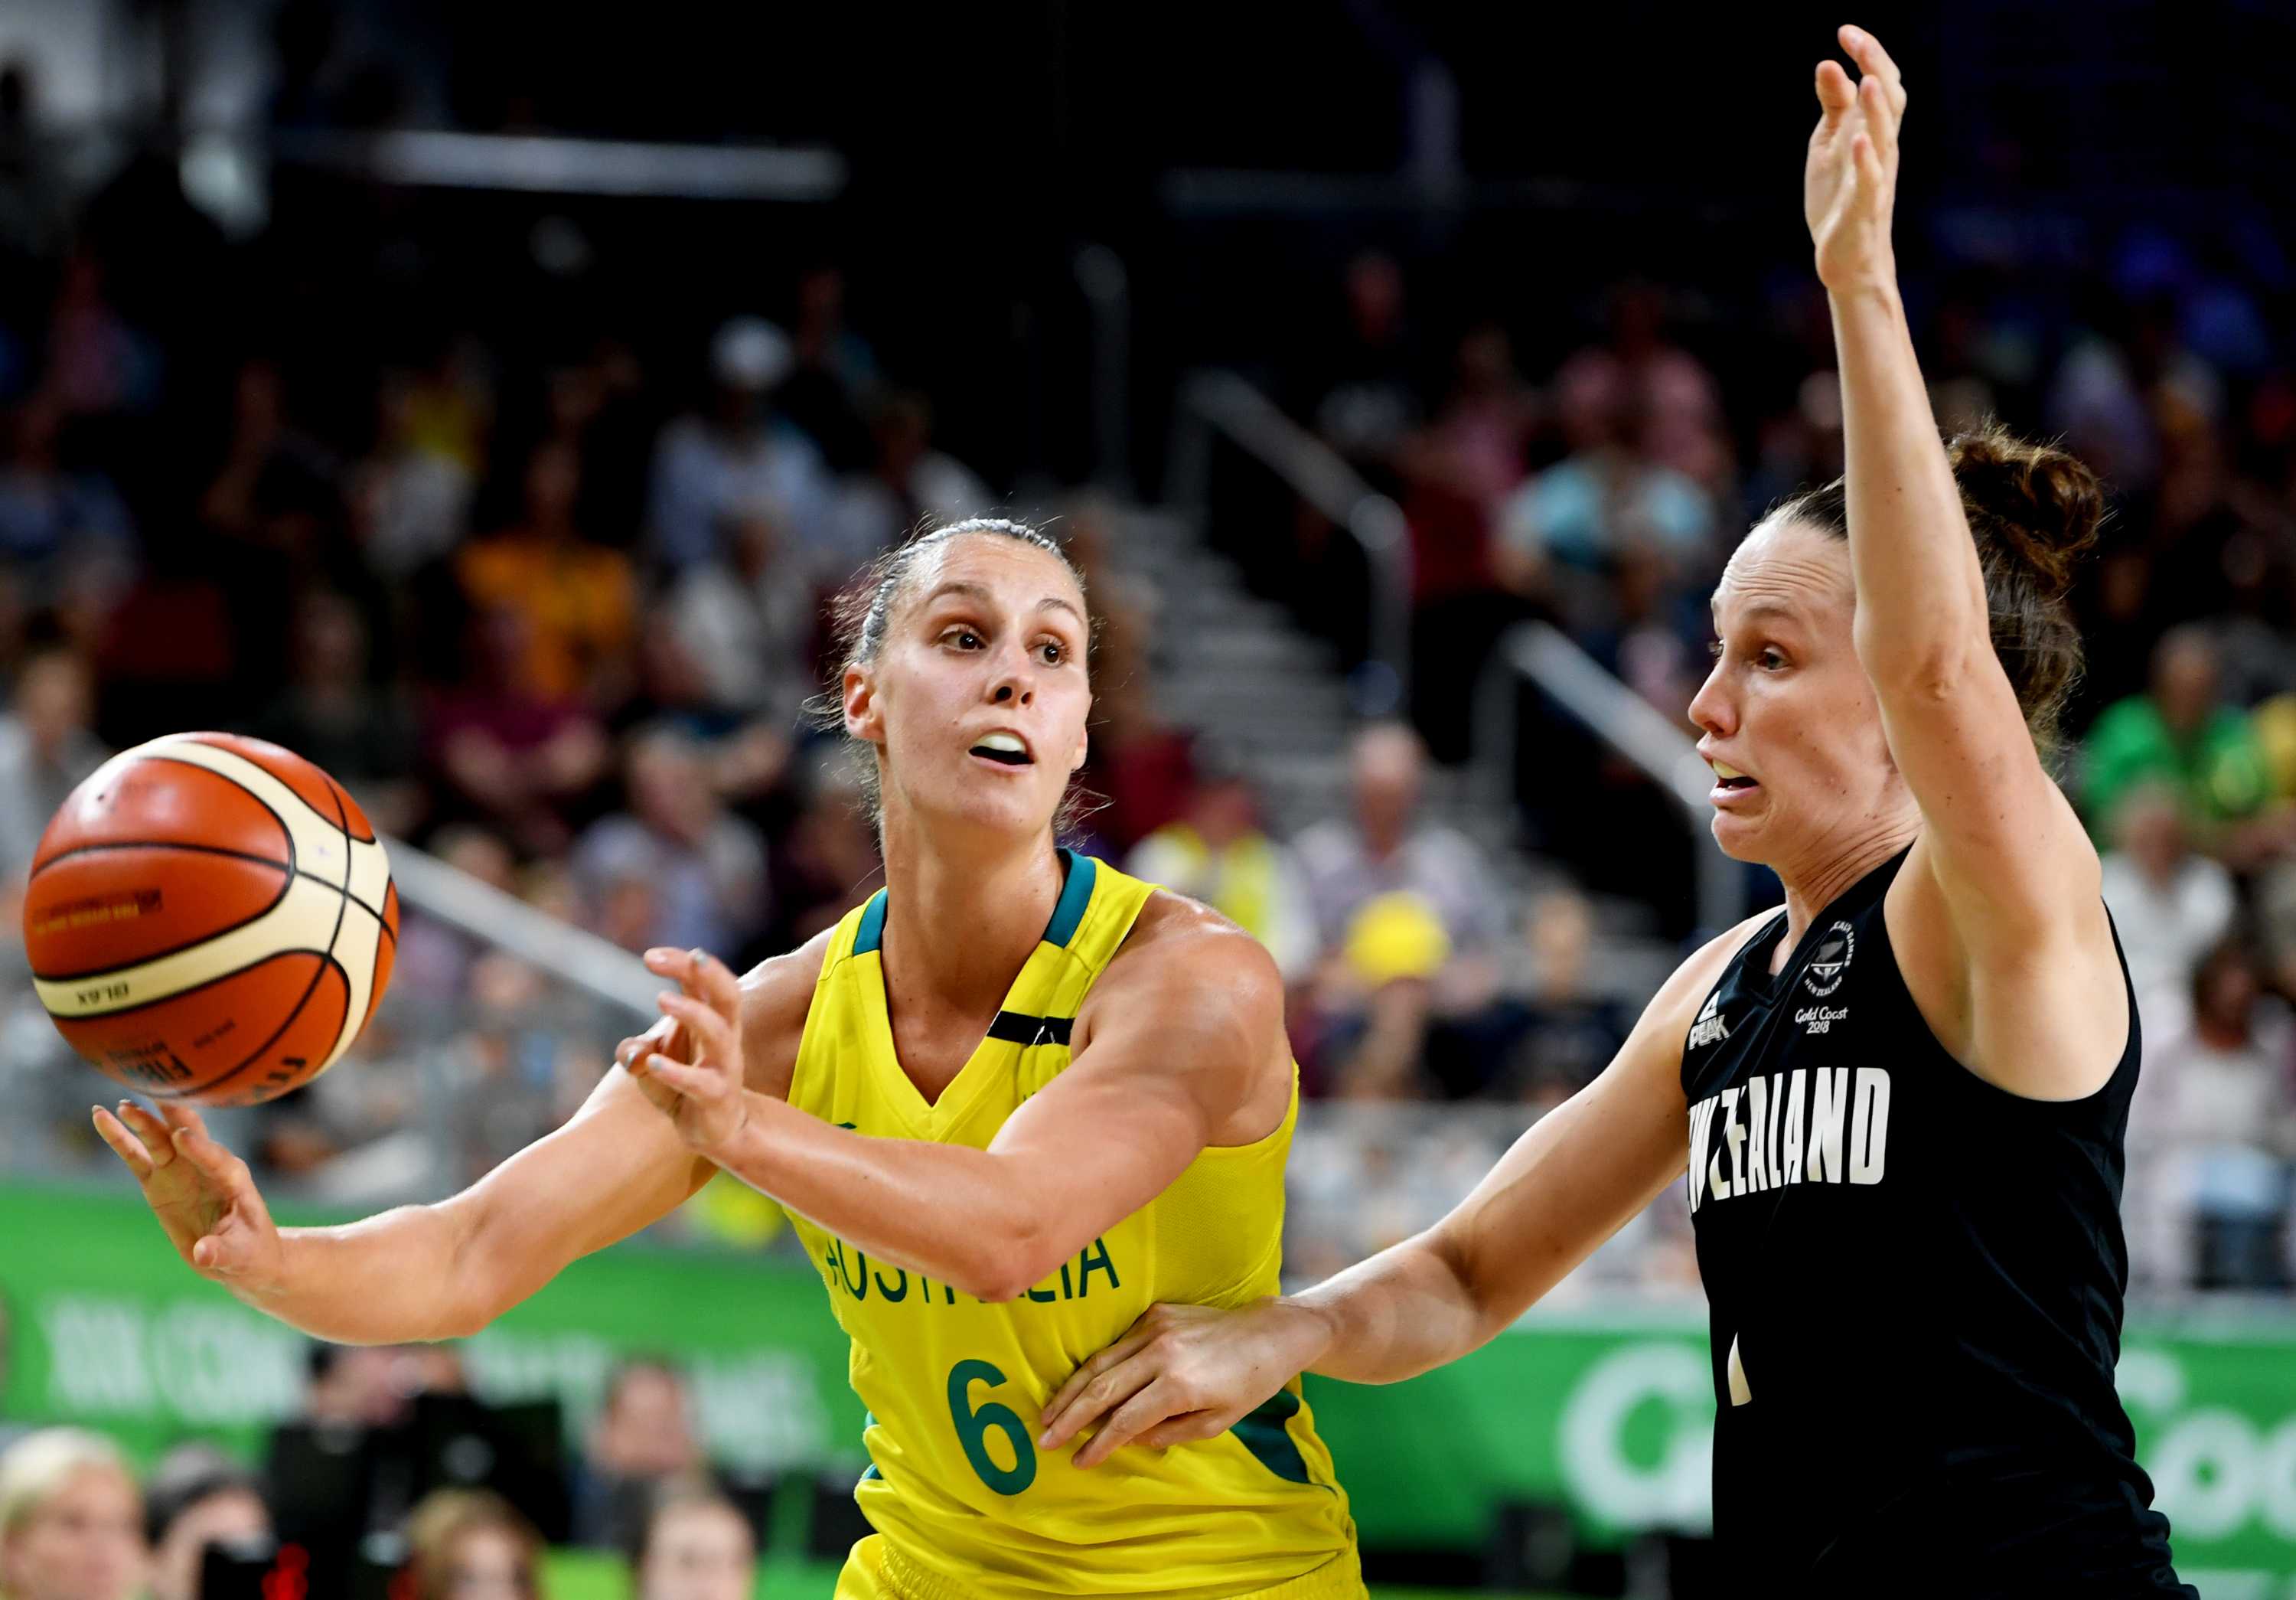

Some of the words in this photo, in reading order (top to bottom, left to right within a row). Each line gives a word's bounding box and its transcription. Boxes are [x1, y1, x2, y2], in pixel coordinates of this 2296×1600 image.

[1688, 1014, 1730, 1050] PEAK
[1795, 1005, 1820, 1024] Gold
[1818, 1005, 1849, 1020] Coast
[1806, 1020, 1830, 1034] 2018
[1709, 1066, 1891, 1201] ZEALAND
[947, 1358, 1037, 1496] 6
